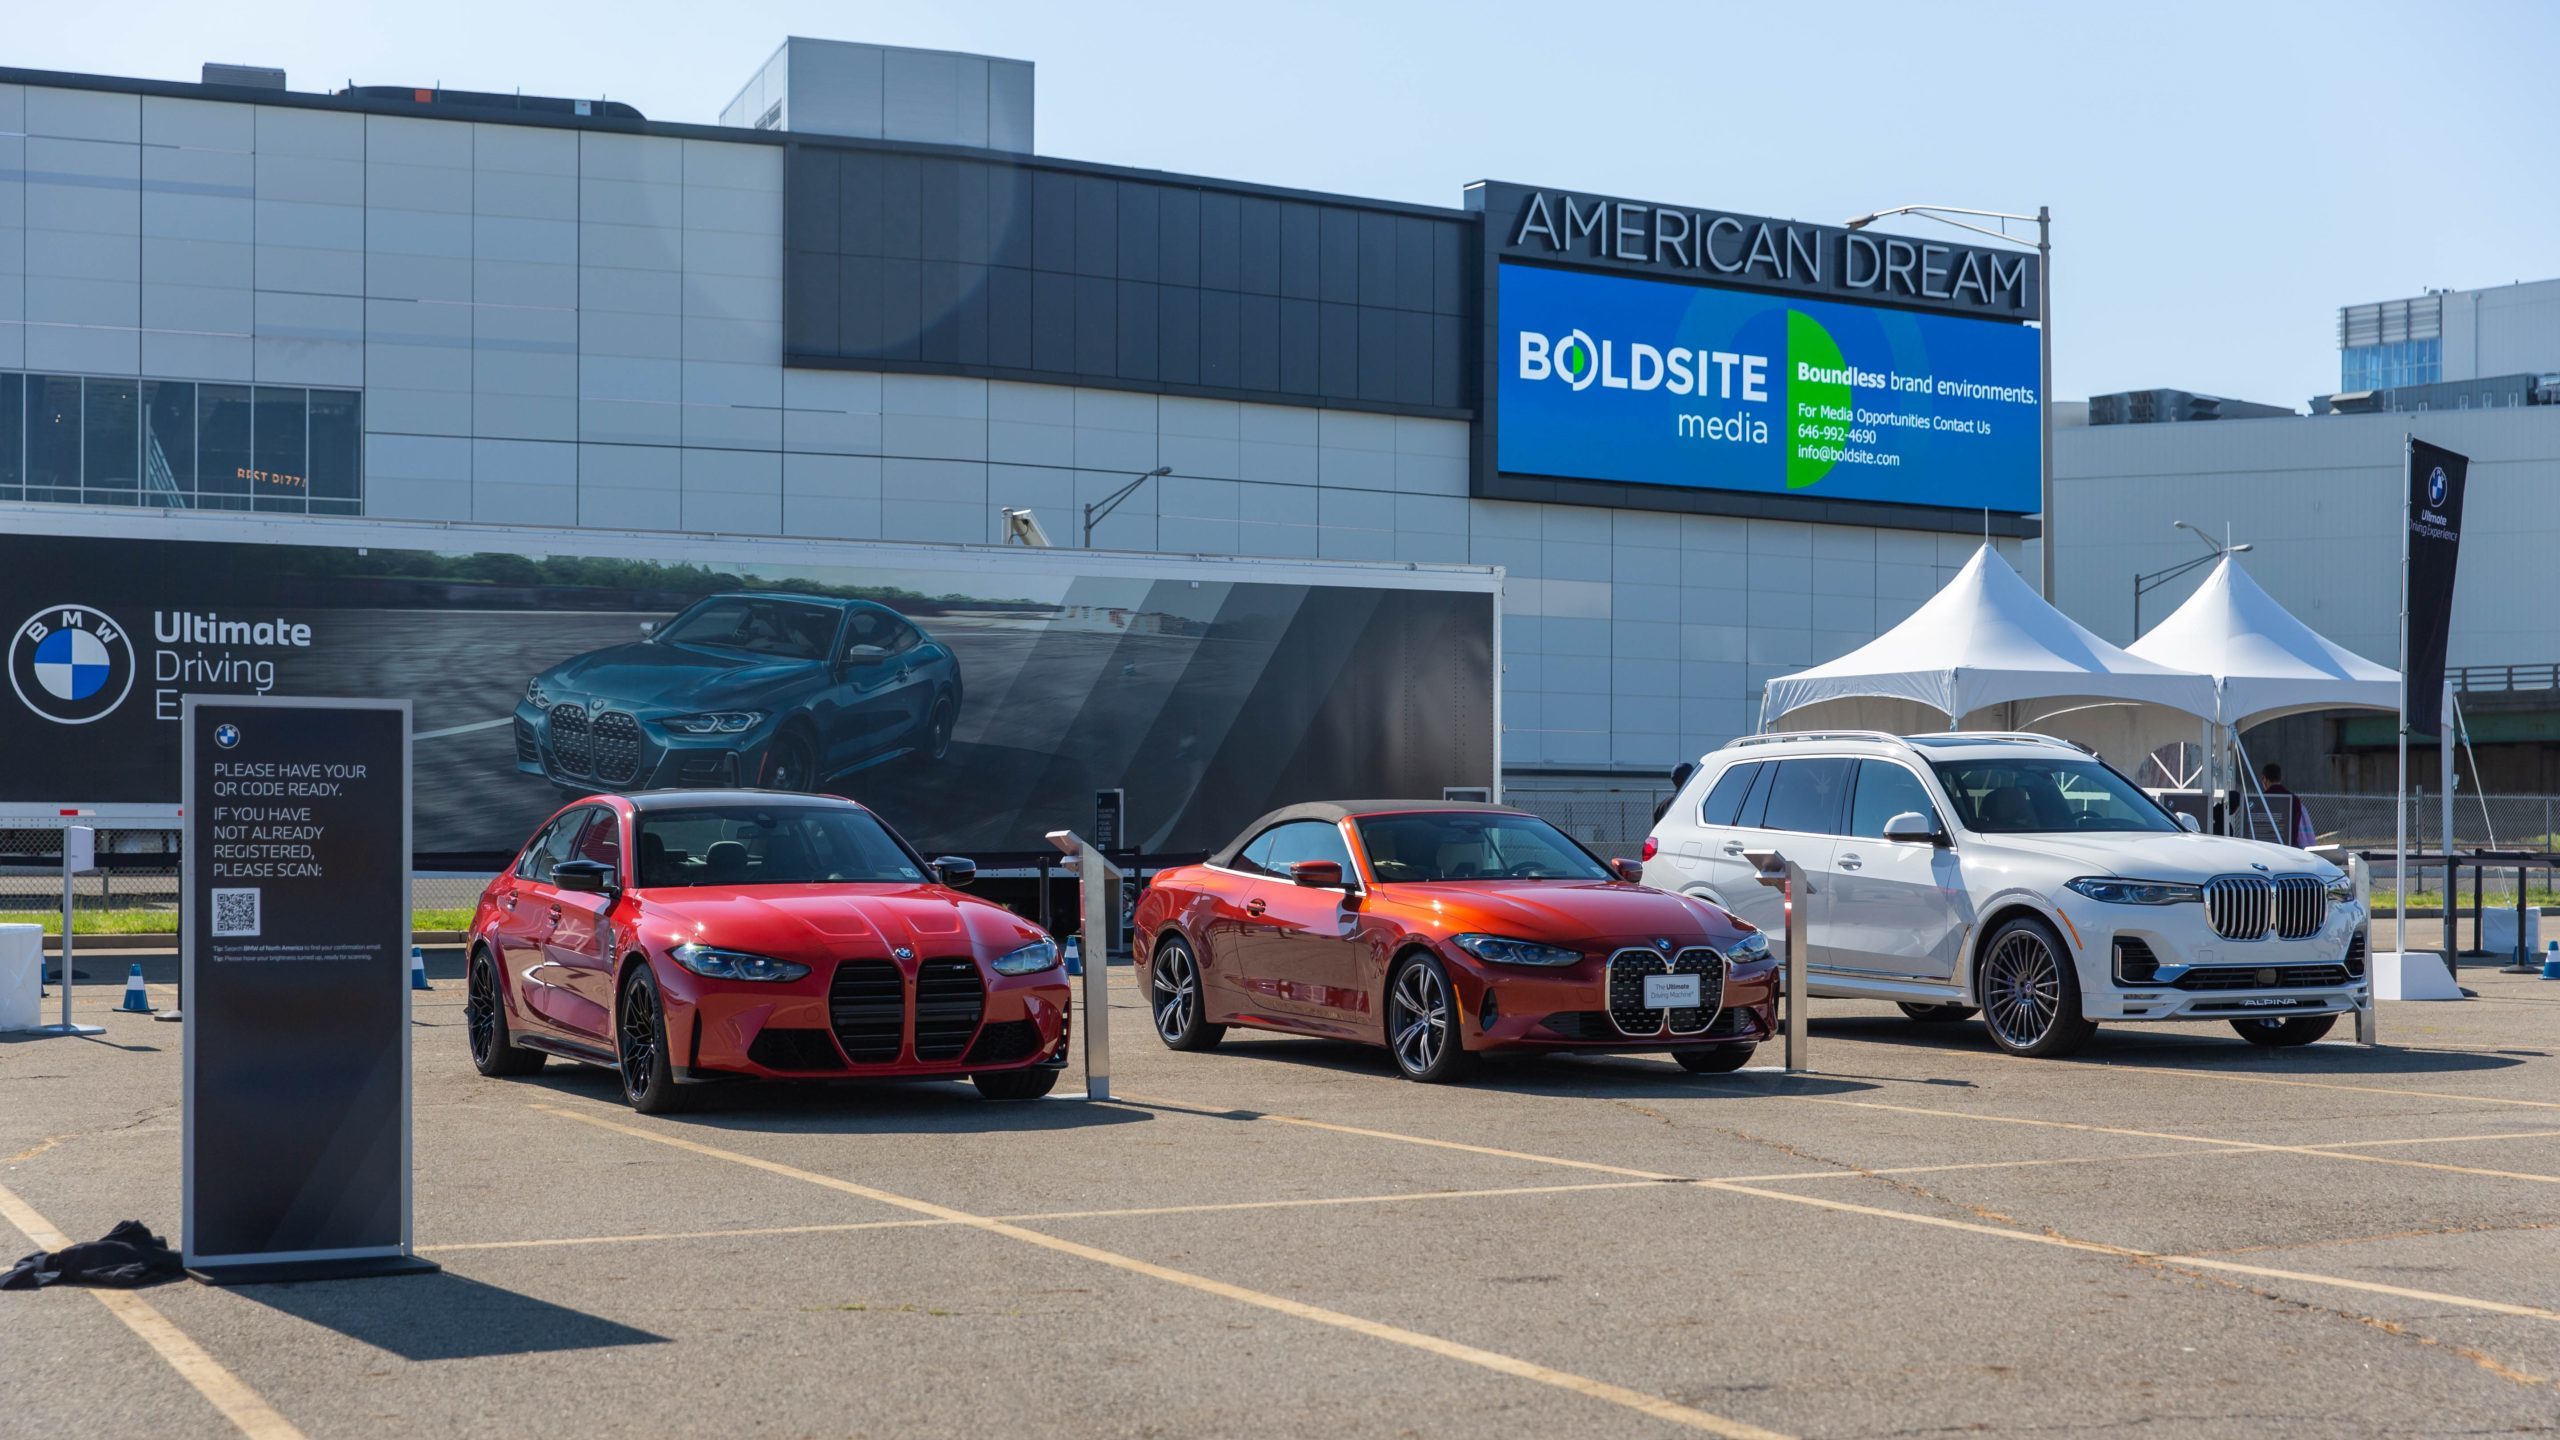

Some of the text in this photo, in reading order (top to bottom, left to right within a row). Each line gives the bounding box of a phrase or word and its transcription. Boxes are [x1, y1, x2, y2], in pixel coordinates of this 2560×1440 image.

[1517, 191, 2028, 309] AMERICAN DREAM
[1519, 328, 1769, 403] BOLDSITE
[1797, 362, 2038, 405] Boundless brand environments.
[1678, 411, 1769, 445] media
[1798, 403, 1991, 435] For Media Opportunities Contact Us
[1798, 424, 1877, 444] 646-992-4690
[1797, 444, 1900, 466] info@boldsite.com
[2421, 509, 2447, 526] Ultimate
[26, 611, 119, 644] BMW
[154, 611, 312, 647] Ultimate
[156, 650, 274, 692] Driving
[214, 763, 367, 779] PLEASE HAVE YOUR
[214, 781, 343, 797] QR CODE READY.
[213, 807, 311, 821] IF YOU HAVE
[213, 826, 324, 840] NOT ALREADY
[213, 844, 315, 860] REGISTERED,
[213, 863, 323, 877] PLEASE SCAN:
[1650, 991, 1669, 1000] Driving
[2244, 998, 2298, 1006] ALPINA
